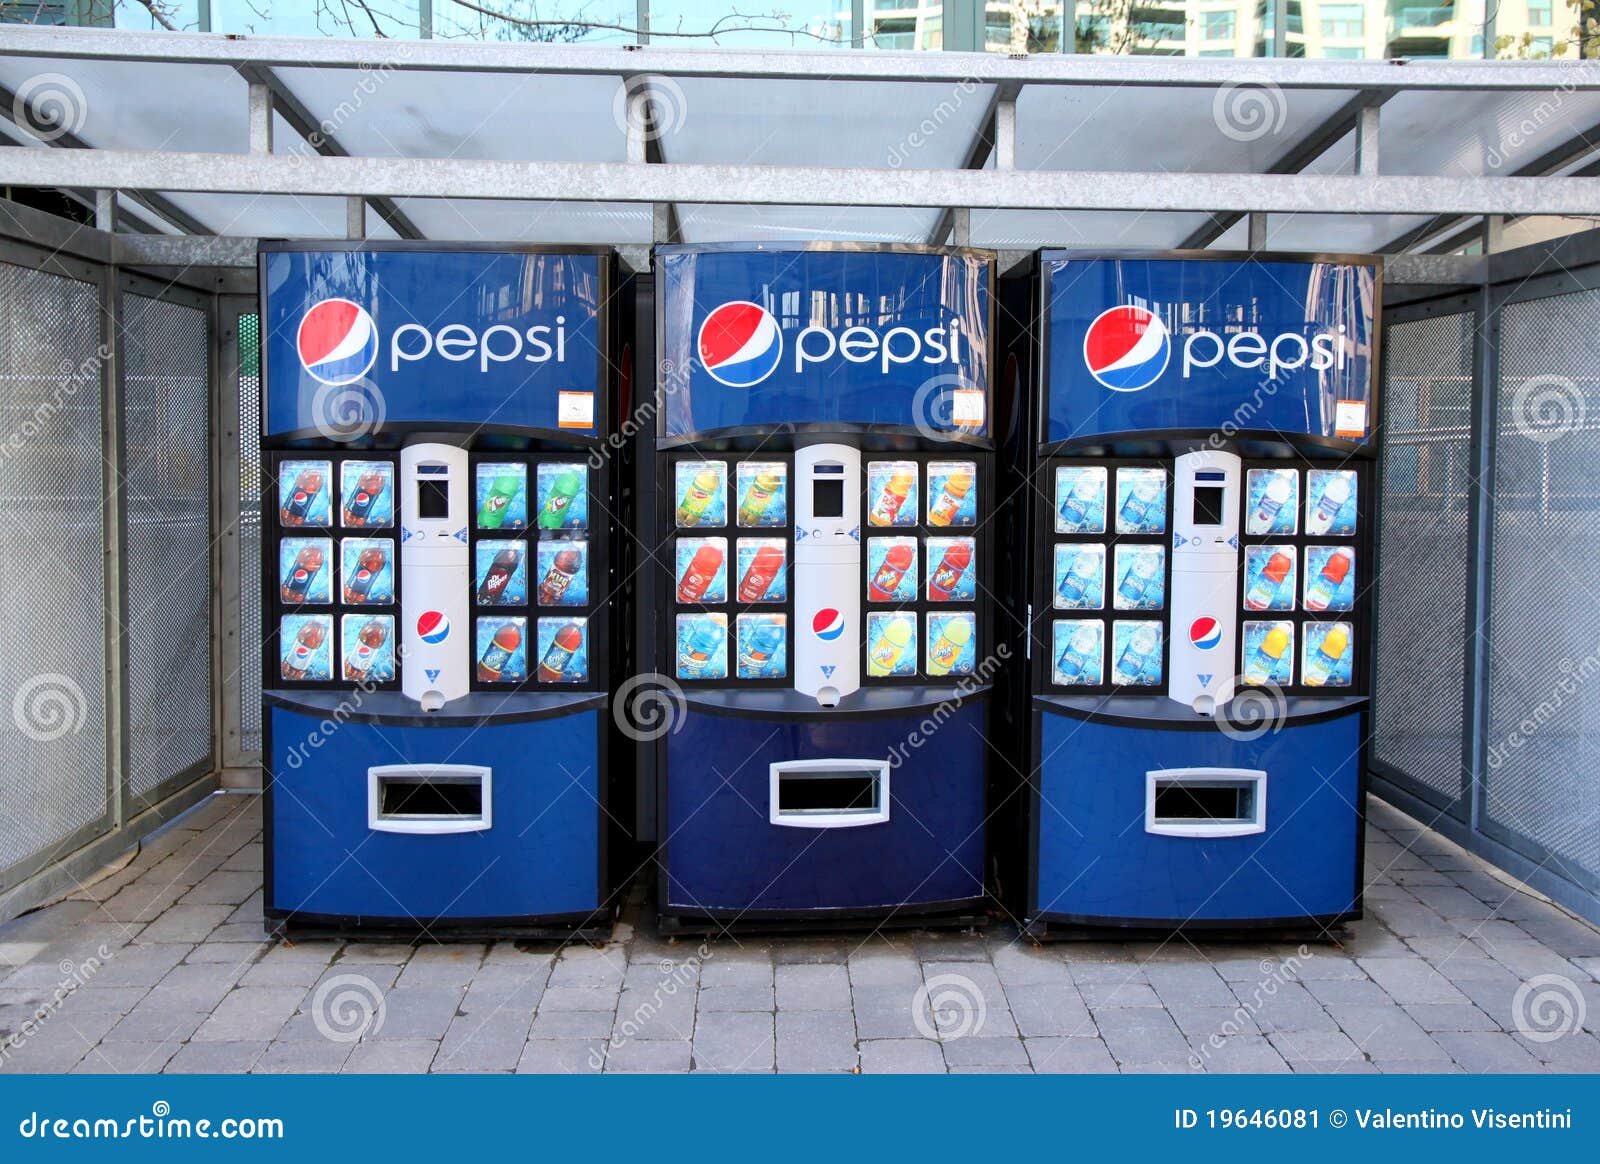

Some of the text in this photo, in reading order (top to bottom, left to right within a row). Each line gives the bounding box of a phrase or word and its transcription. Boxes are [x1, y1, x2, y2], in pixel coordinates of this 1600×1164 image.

[391, 316, 565, 372] pepsi
[795, 318, 960, 374] pepsi
[1183, 325, 1346, 380] pepsi
